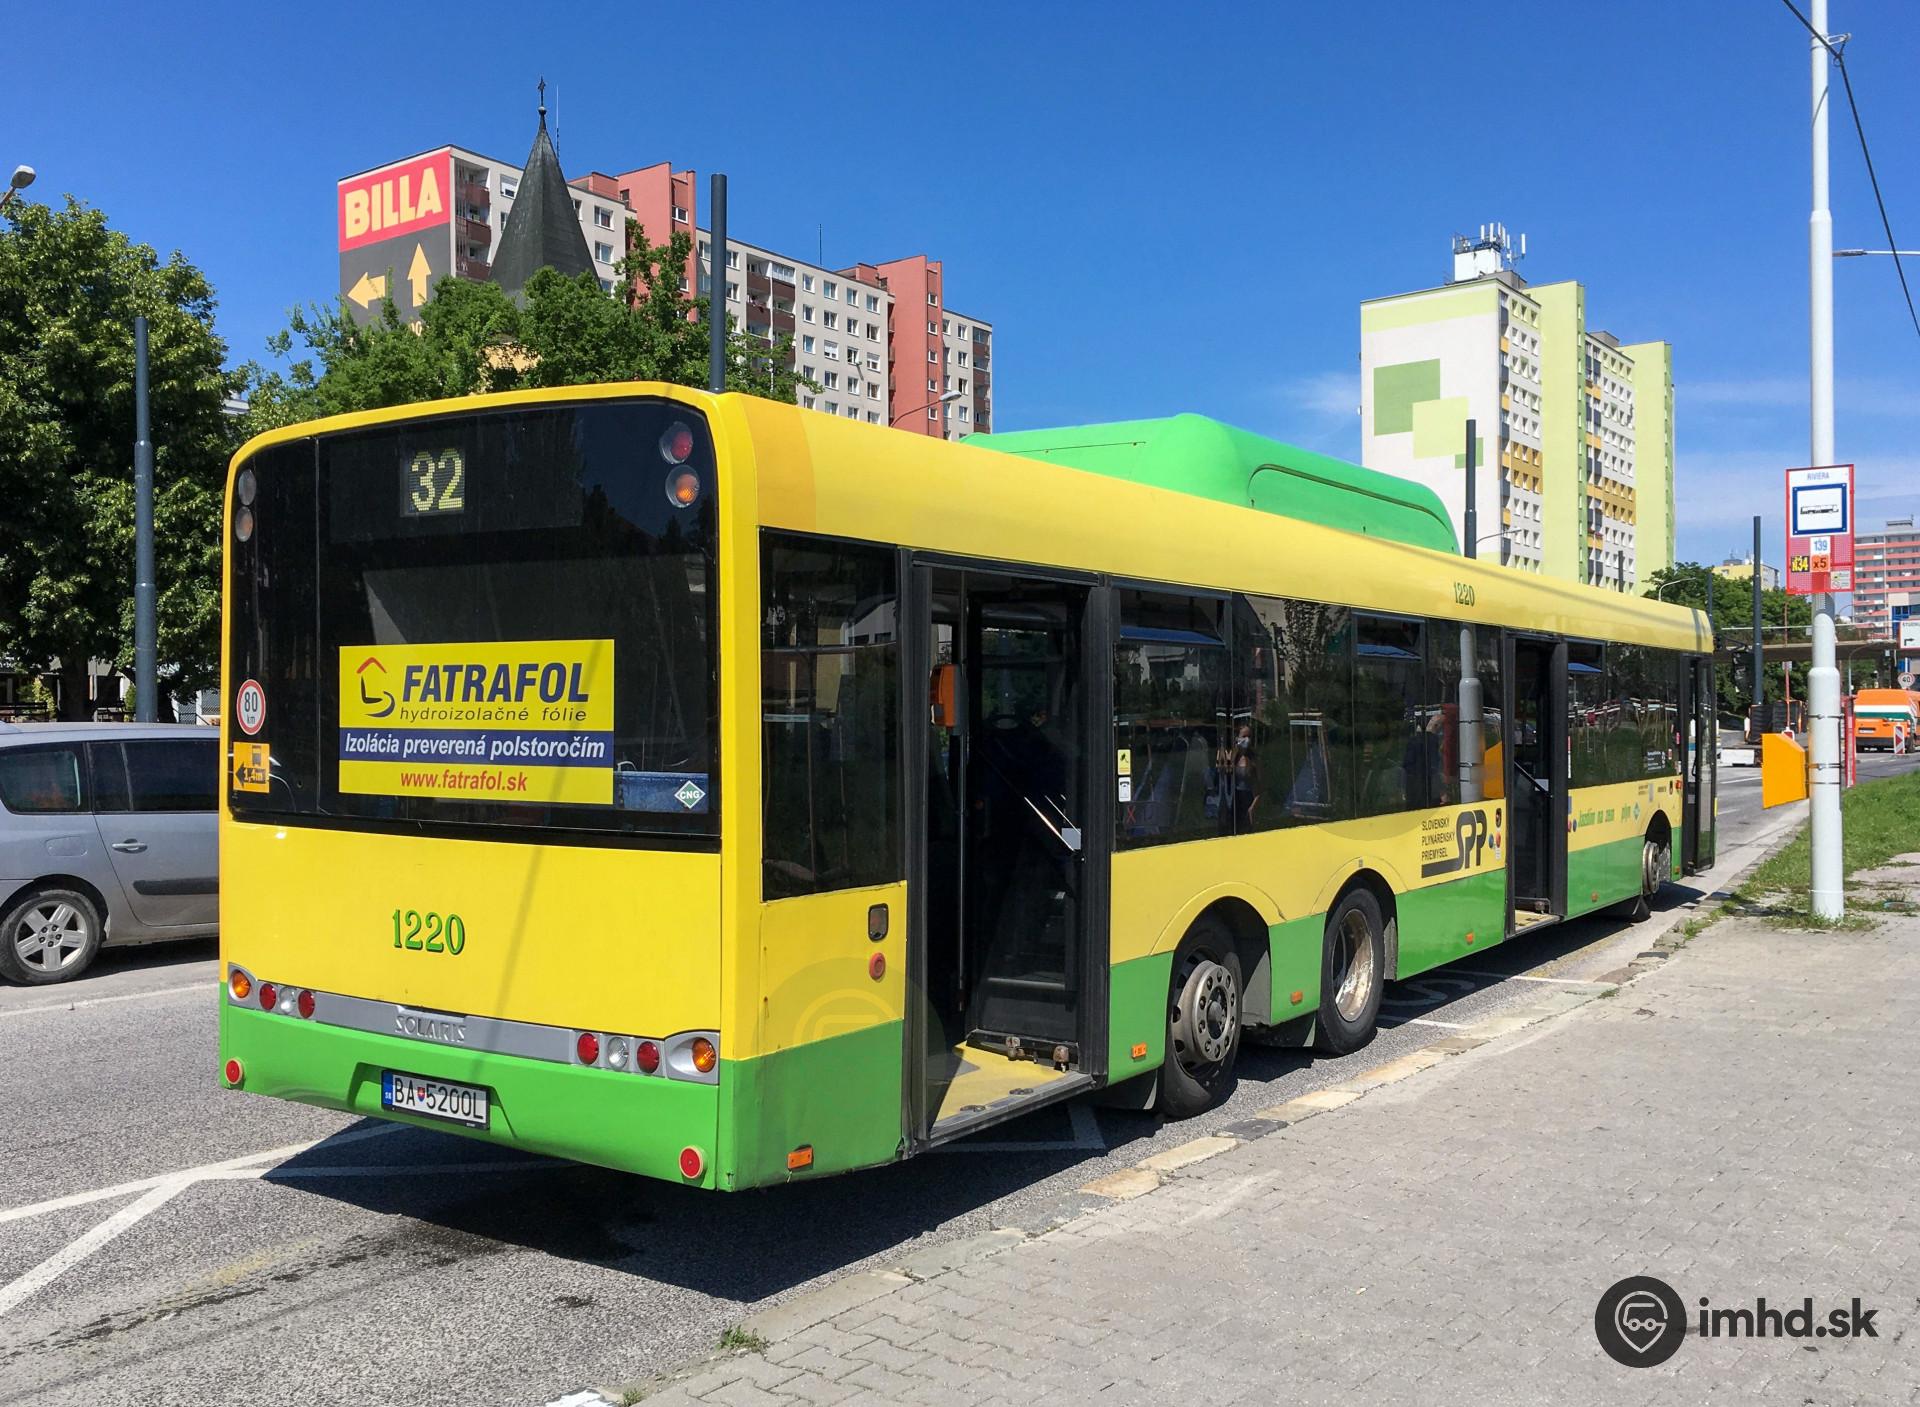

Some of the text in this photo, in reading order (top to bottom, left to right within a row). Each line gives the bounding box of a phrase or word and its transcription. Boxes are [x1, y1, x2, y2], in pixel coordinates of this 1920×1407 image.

[345, 167, 443, 240] BILLA
[411, 448, 462, 511] 32
[1807, 471, 1830, 480] RIVIERA
[1814, 539, 1828, 551] 139
[1454, 582, 1475, 607] 1220
[402, 662, 589, 703] FATRAFOL
[244, 691, 258, 712] 80
[246, 714, 256, 724] km
[400, 706, 587, 723] hydroizolačné fólie
[345, 732, 605, 760] Izolácia preverená polstoročím
[400, 769, 527, 792] www.fatrafol.sk
[679, 790, 701, 800] CNG
[393, 909, 465, 955] 1220
[395, 1015, 467, 1043] SOLARIS
[394, 1077, 416, 1106] BA
[425, 1083, 484, 1119] 5200L
